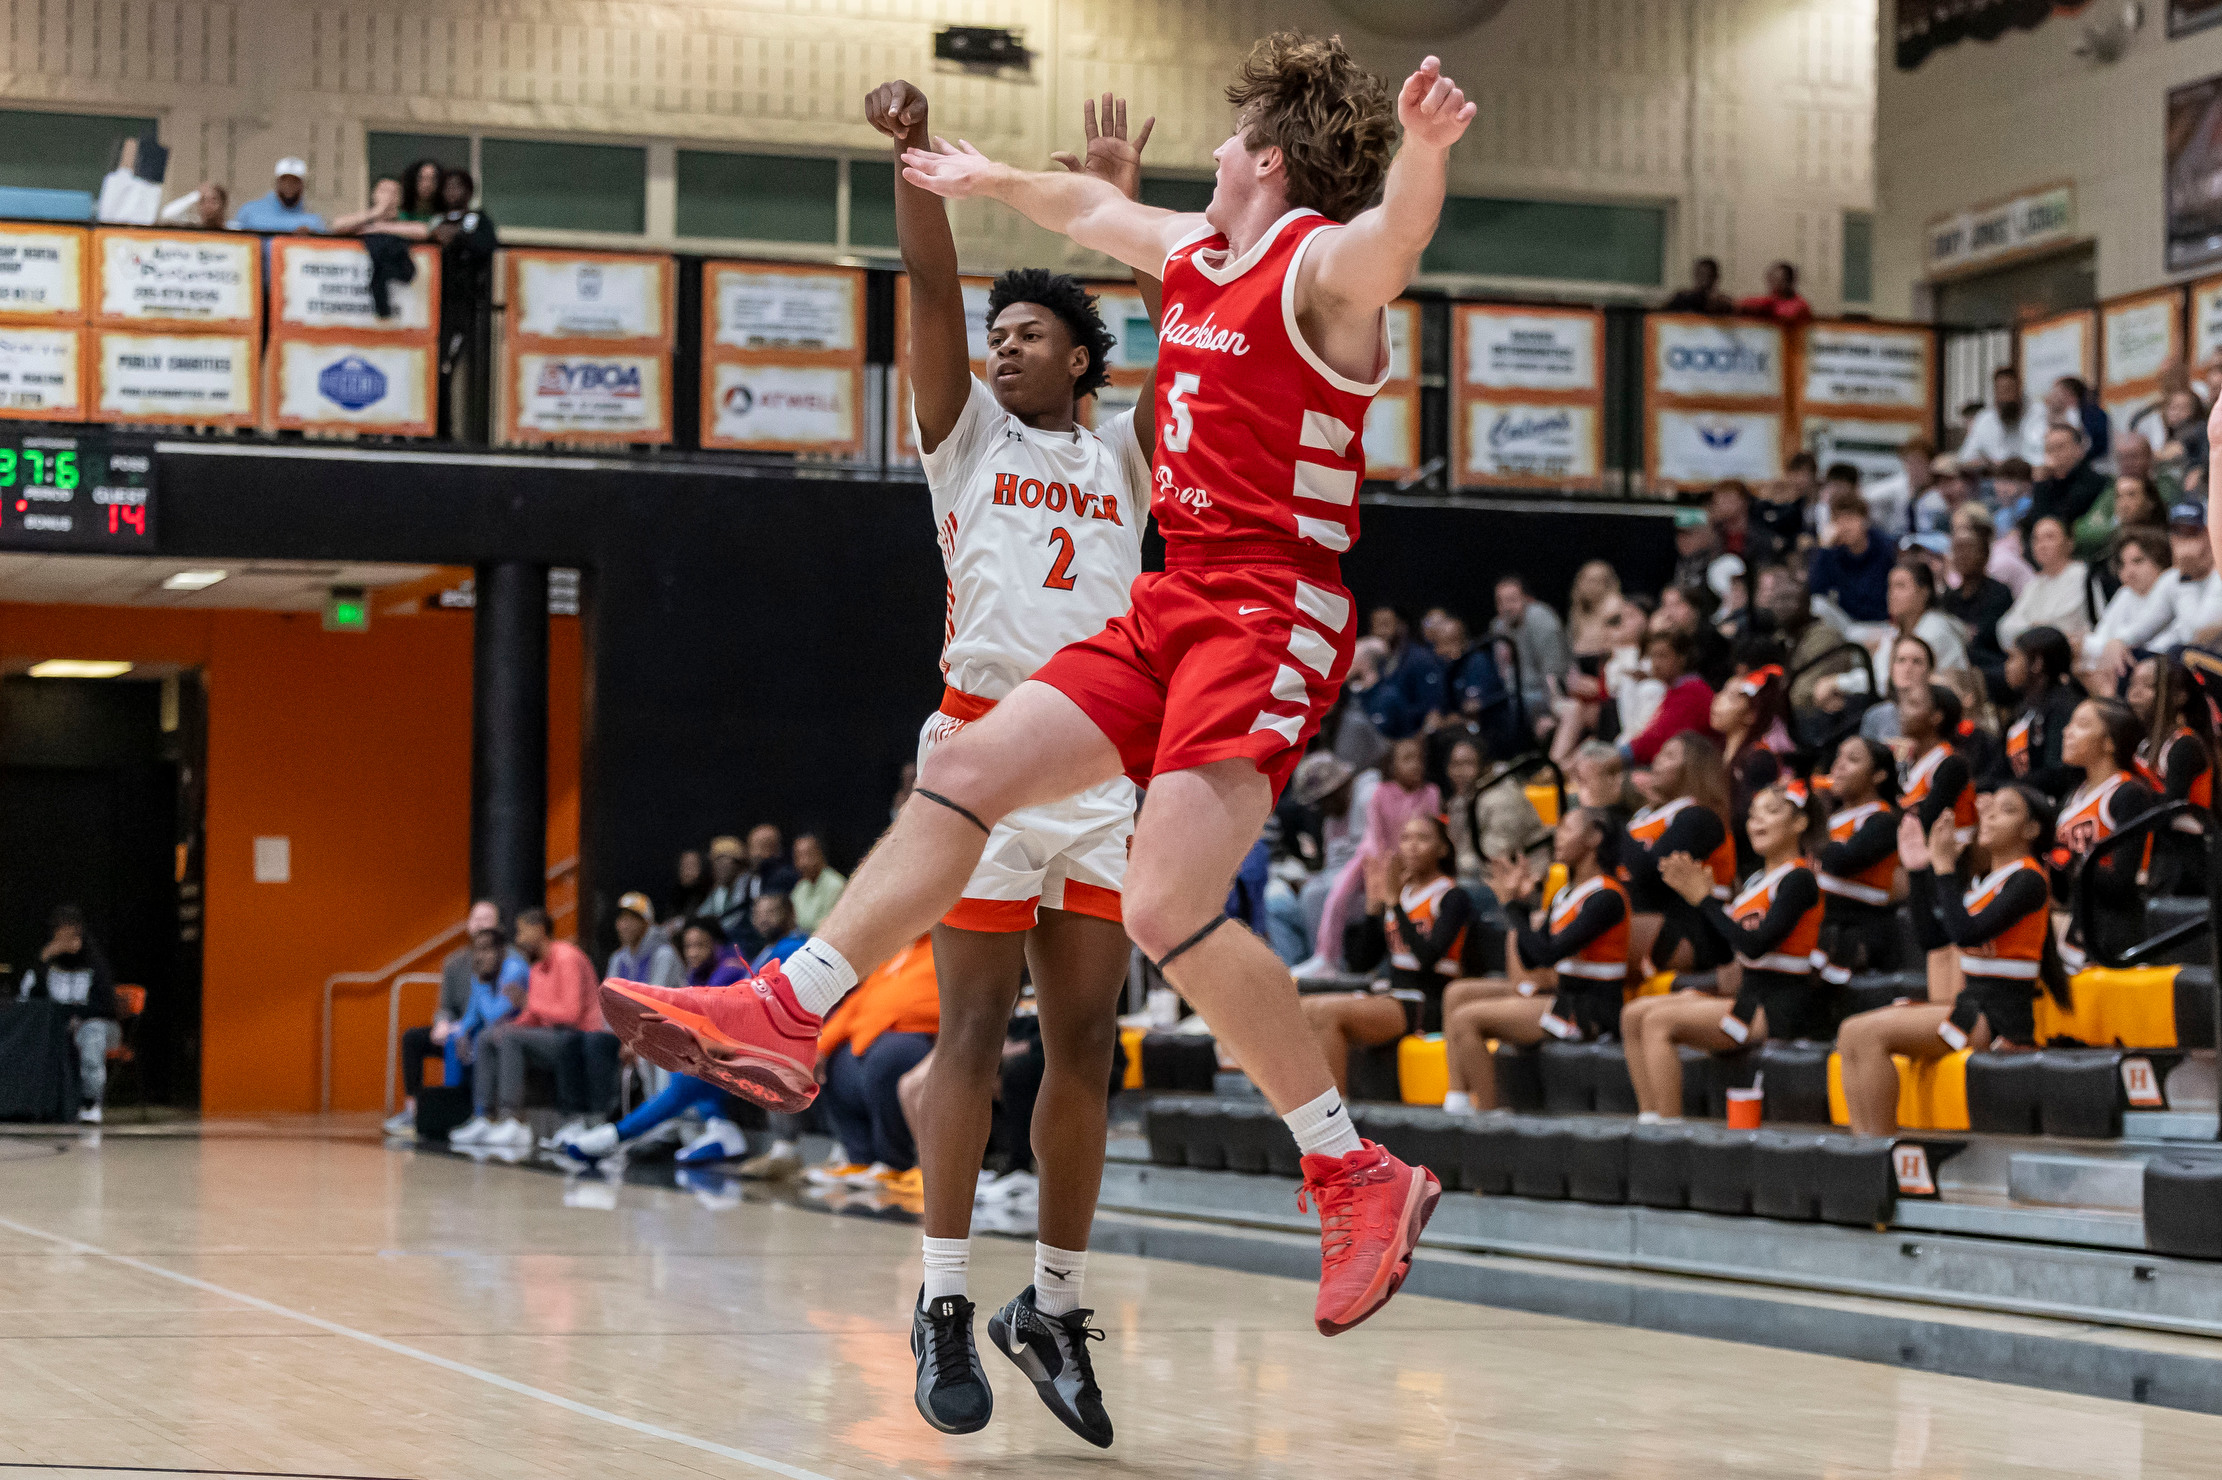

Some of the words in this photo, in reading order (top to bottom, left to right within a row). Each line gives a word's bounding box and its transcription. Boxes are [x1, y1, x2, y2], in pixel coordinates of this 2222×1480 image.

[1159, 303, 1250, 356] Jackson
[1163, 371, 1200, 453] 5
[108, 503, 146, 535] 14
[992, 473, 1124, 526] HOOVER
[1042, 527, 1078, 591] 2
[2129, 1068, 2148, 1090] H
[1901, 1154, 1920, 1178] H
